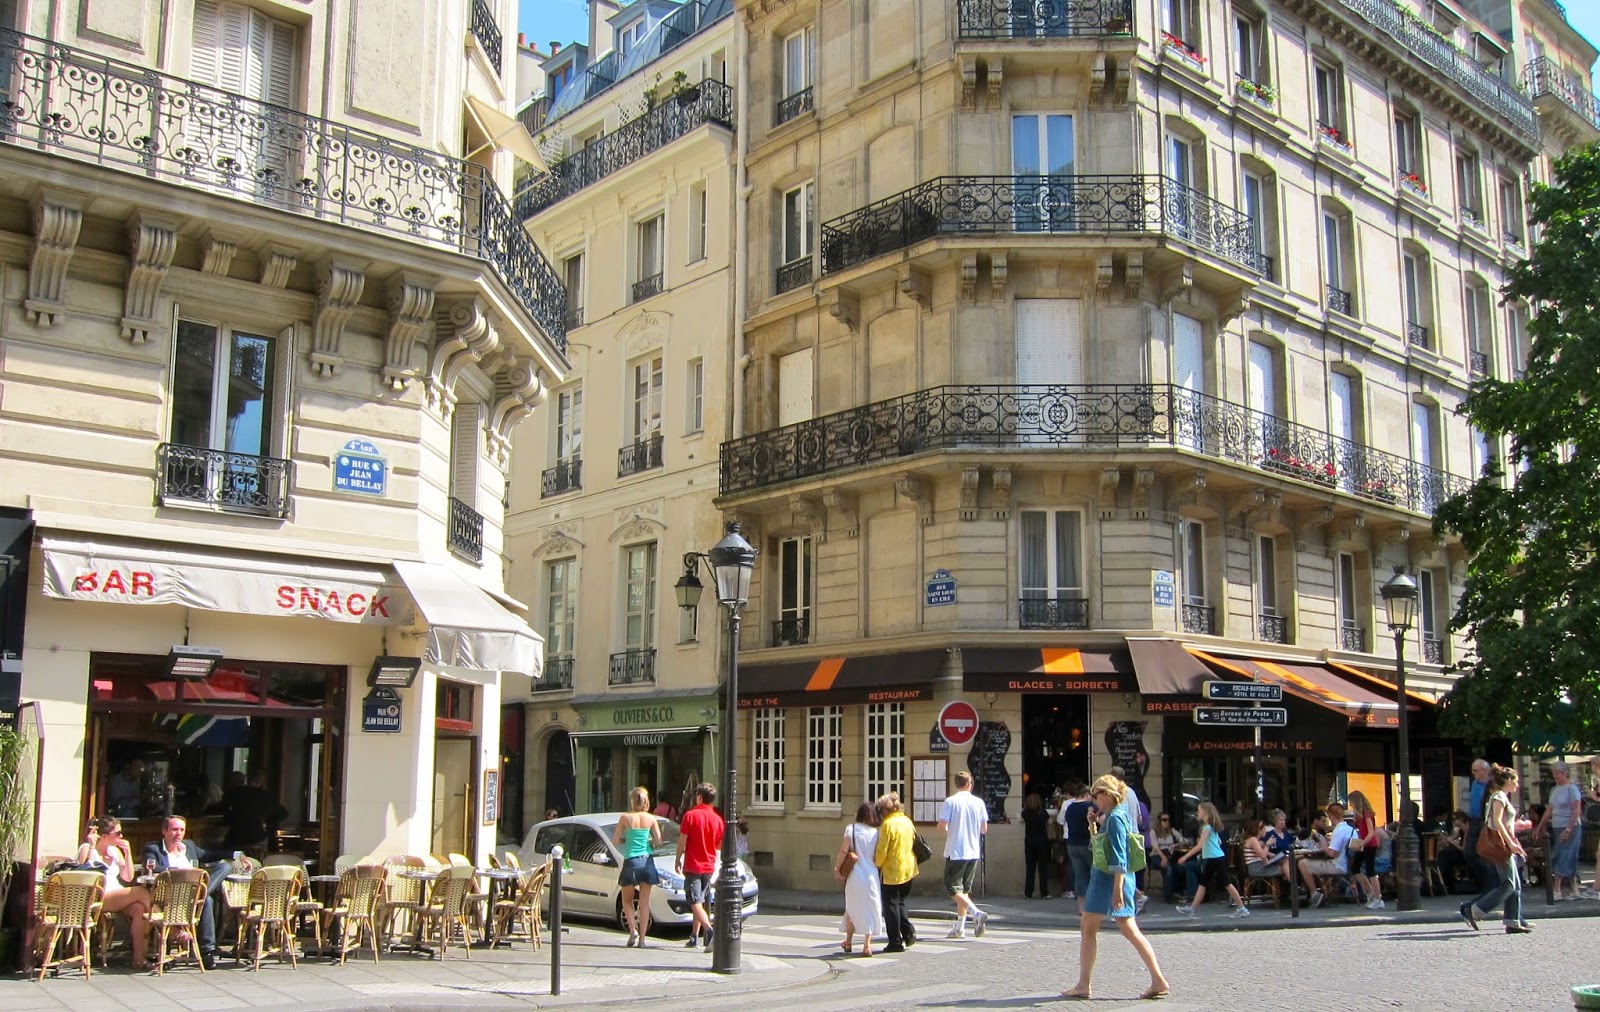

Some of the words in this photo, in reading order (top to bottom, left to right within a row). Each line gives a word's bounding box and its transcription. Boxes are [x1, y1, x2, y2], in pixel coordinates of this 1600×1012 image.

[351, 459, 370, 470] RUE
[349, 469, 372, 479] JEAN
[337, 476, 349, 486] DU
[350, 478, 383, 490] BELLAY
[71, 569, 155, 596] BAR
[276, 585, 390, 618] SNACK
[1008, 681, 1054, 689] GLACES
[1065, 681, 1119, 689] SORBETS
[868, 690, 921, 700] RESTAURANT
[377, 708, 387, 716] RUE
[365, 717, 376, 725] JEAN
[377, 717, 384, 725] DU
[383, 718, 399, 726] BELLAY
[1188, 741, 1200, 750] LA
[1203, 741, 1257, 750] CHAUMIER
[1263, 741, 1278, 750] EN
[1537, 740, 1557, 753] de
